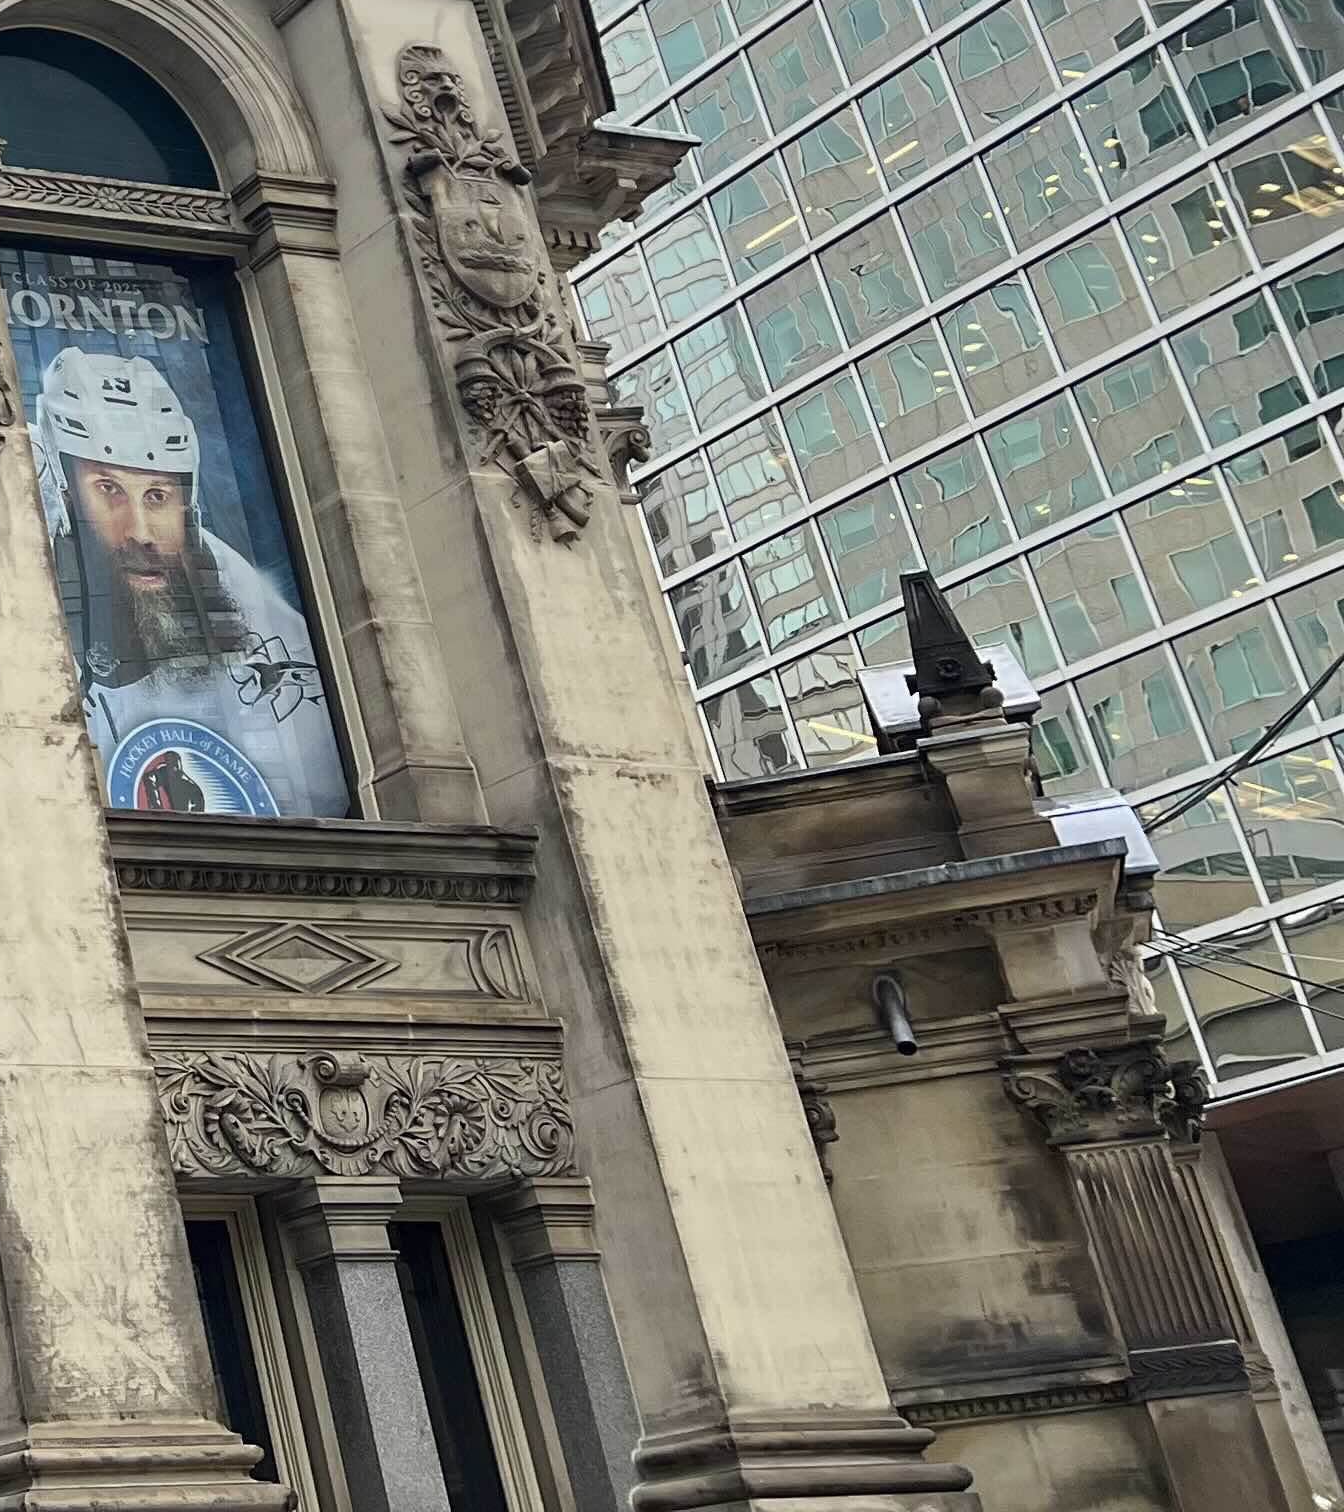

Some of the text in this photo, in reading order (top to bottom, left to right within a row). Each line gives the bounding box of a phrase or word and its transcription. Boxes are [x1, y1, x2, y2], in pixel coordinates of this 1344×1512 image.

[12, 271, 142, 296] CLASS OF 2025
[119, 729, 252, 784] HOCKEY HALL of FAME
